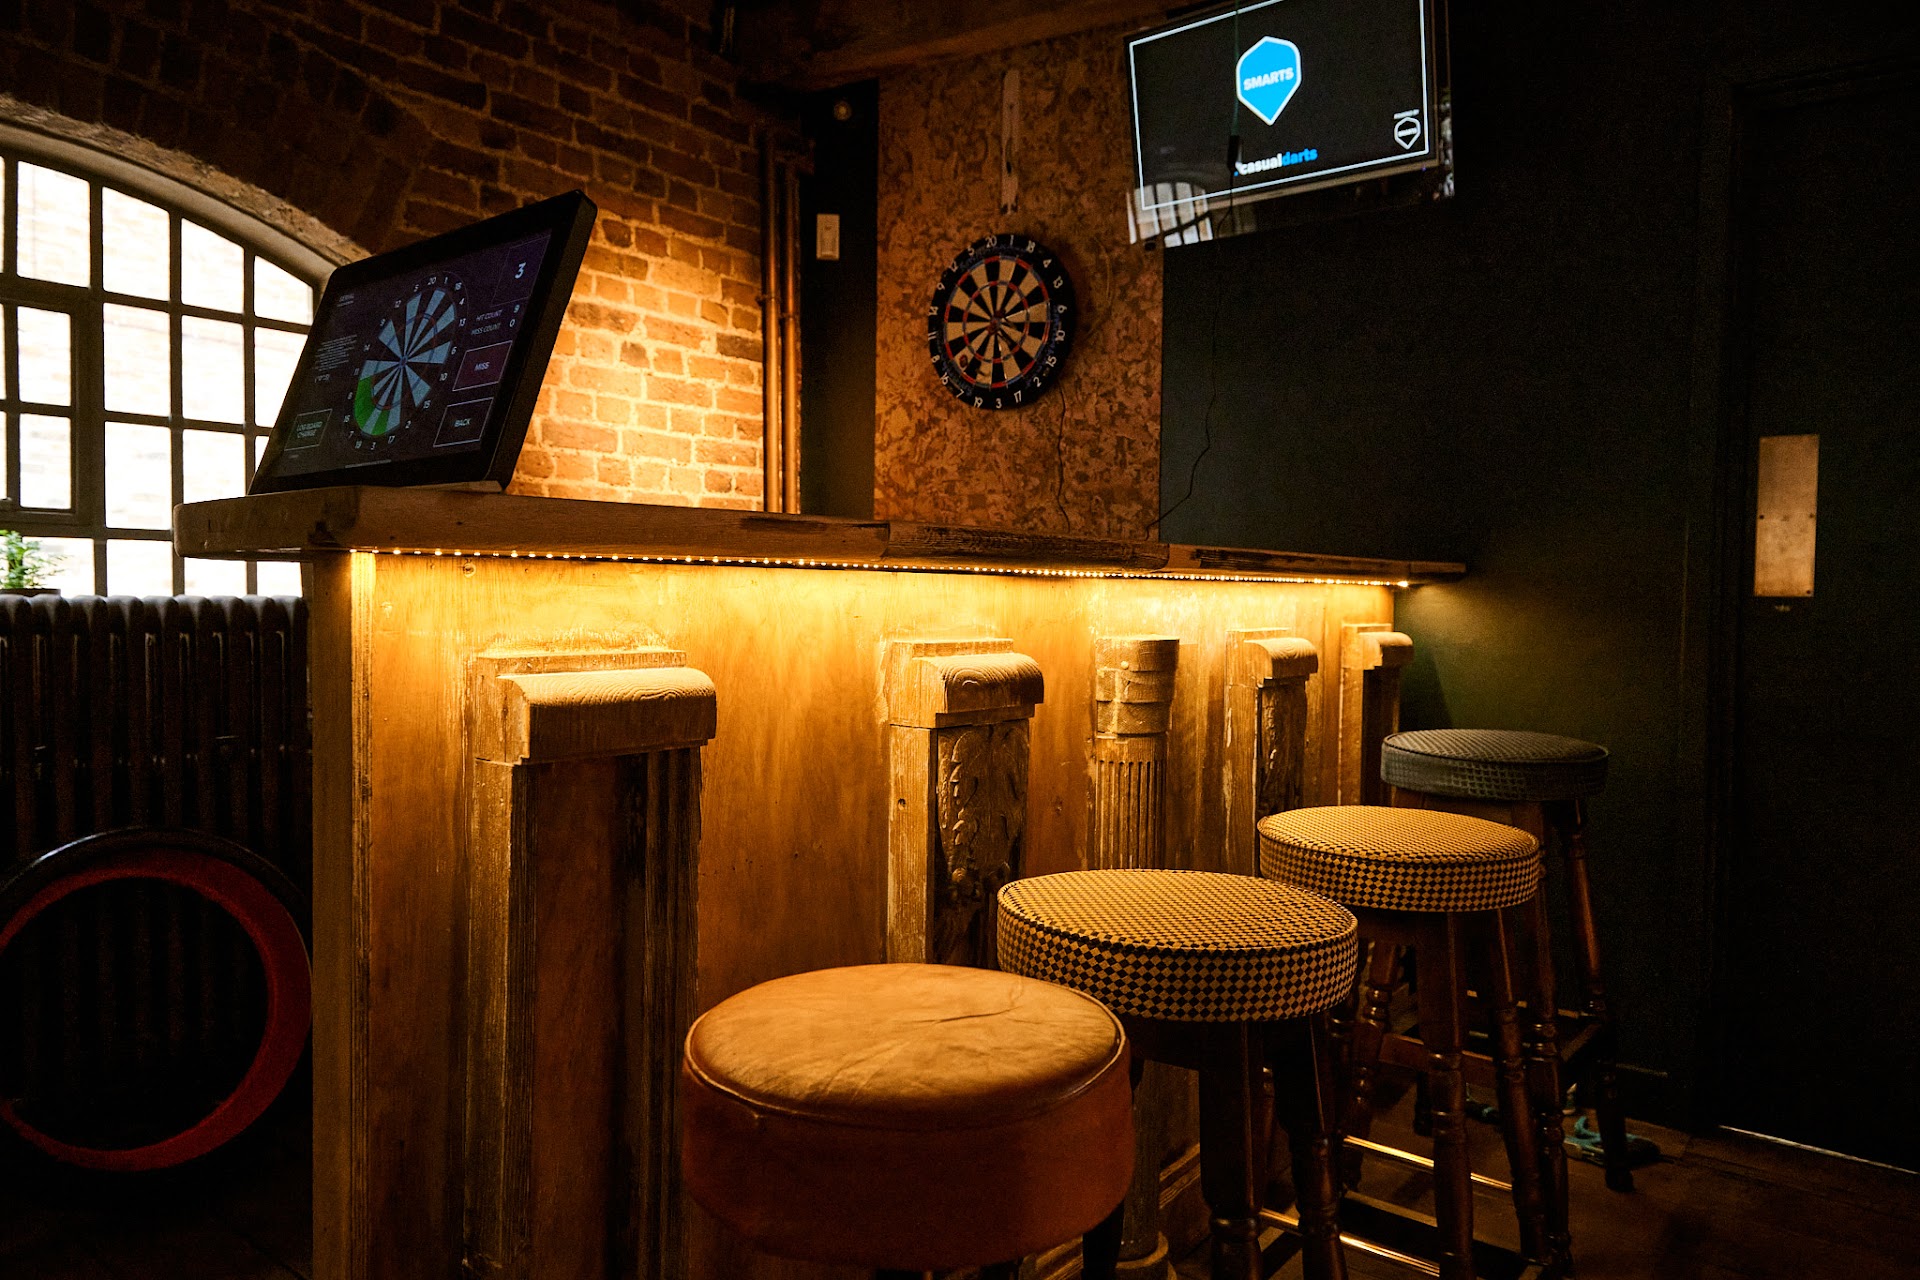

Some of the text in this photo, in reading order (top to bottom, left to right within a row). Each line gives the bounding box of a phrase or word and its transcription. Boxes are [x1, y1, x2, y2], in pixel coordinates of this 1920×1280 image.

[1243, 67, 1294, 91] SMARTS
[1240, 148, 1318, 175] casualdarts
[514, 261, 527, 279] 3
[474, 361, 491, 372] MISS
[454, 417, 472, 428] BACK
